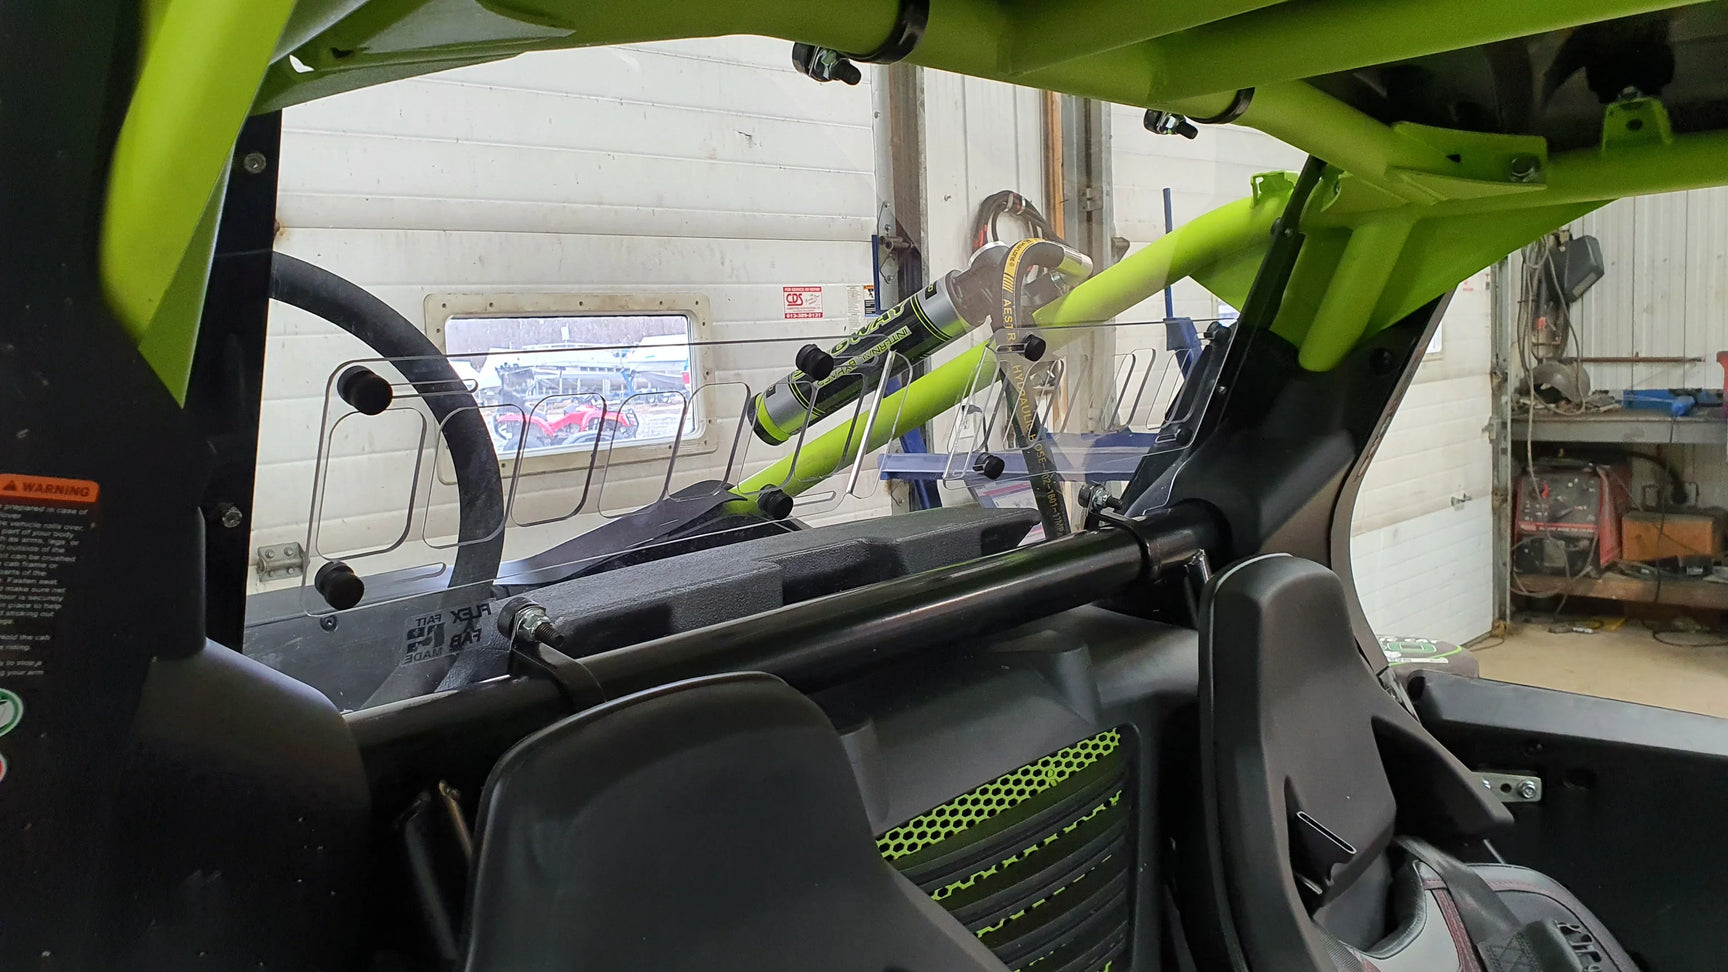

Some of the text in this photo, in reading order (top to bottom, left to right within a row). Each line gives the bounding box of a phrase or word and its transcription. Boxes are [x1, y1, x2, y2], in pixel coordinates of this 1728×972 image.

[786, 293, 804, 306] CDS
[22, 481, 91, 497] WARNING
[53, 531, 75, 540] body
